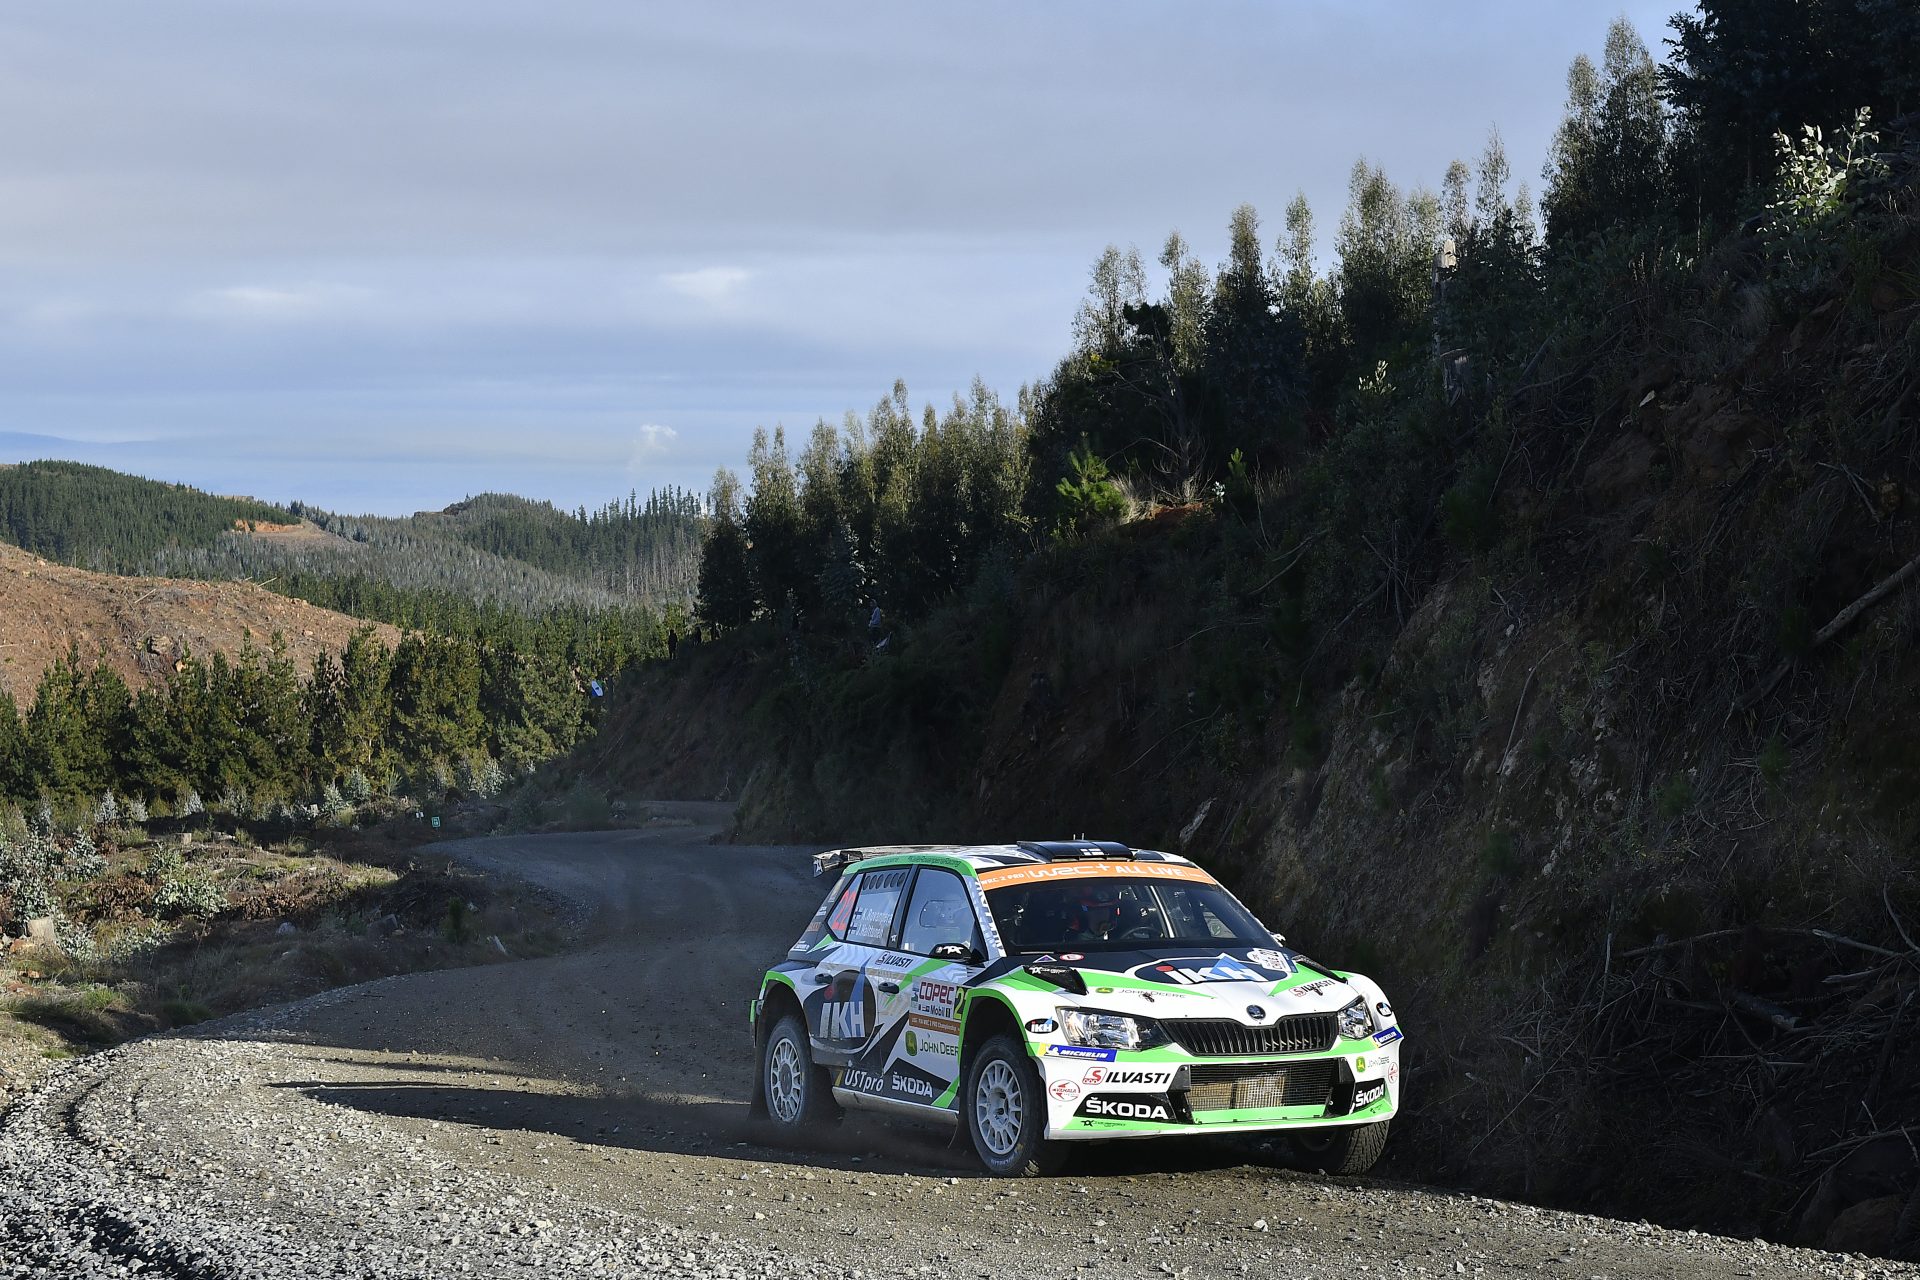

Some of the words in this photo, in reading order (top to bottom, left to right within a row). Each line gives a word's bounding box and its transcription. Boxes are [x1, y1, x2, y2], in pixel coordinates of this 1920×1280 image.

[1115, 864, 1148, 875] ALL
[1148, 866, 1186, 877] LIVE
[875, 951, 913, 968] SILVASTI
[919, 1039, 939, 1053] JOHN
[1060, 1049, 1108, 1058] MICHELIN
[891, 1071, 933, 1098] ŠKODA
[1083, 1067, 1170, 1085] SILVASTI
[1355, 1083, 1385, 1107] ŠKODA
[1086, 1097, 1169, 1119] ŠKODA
